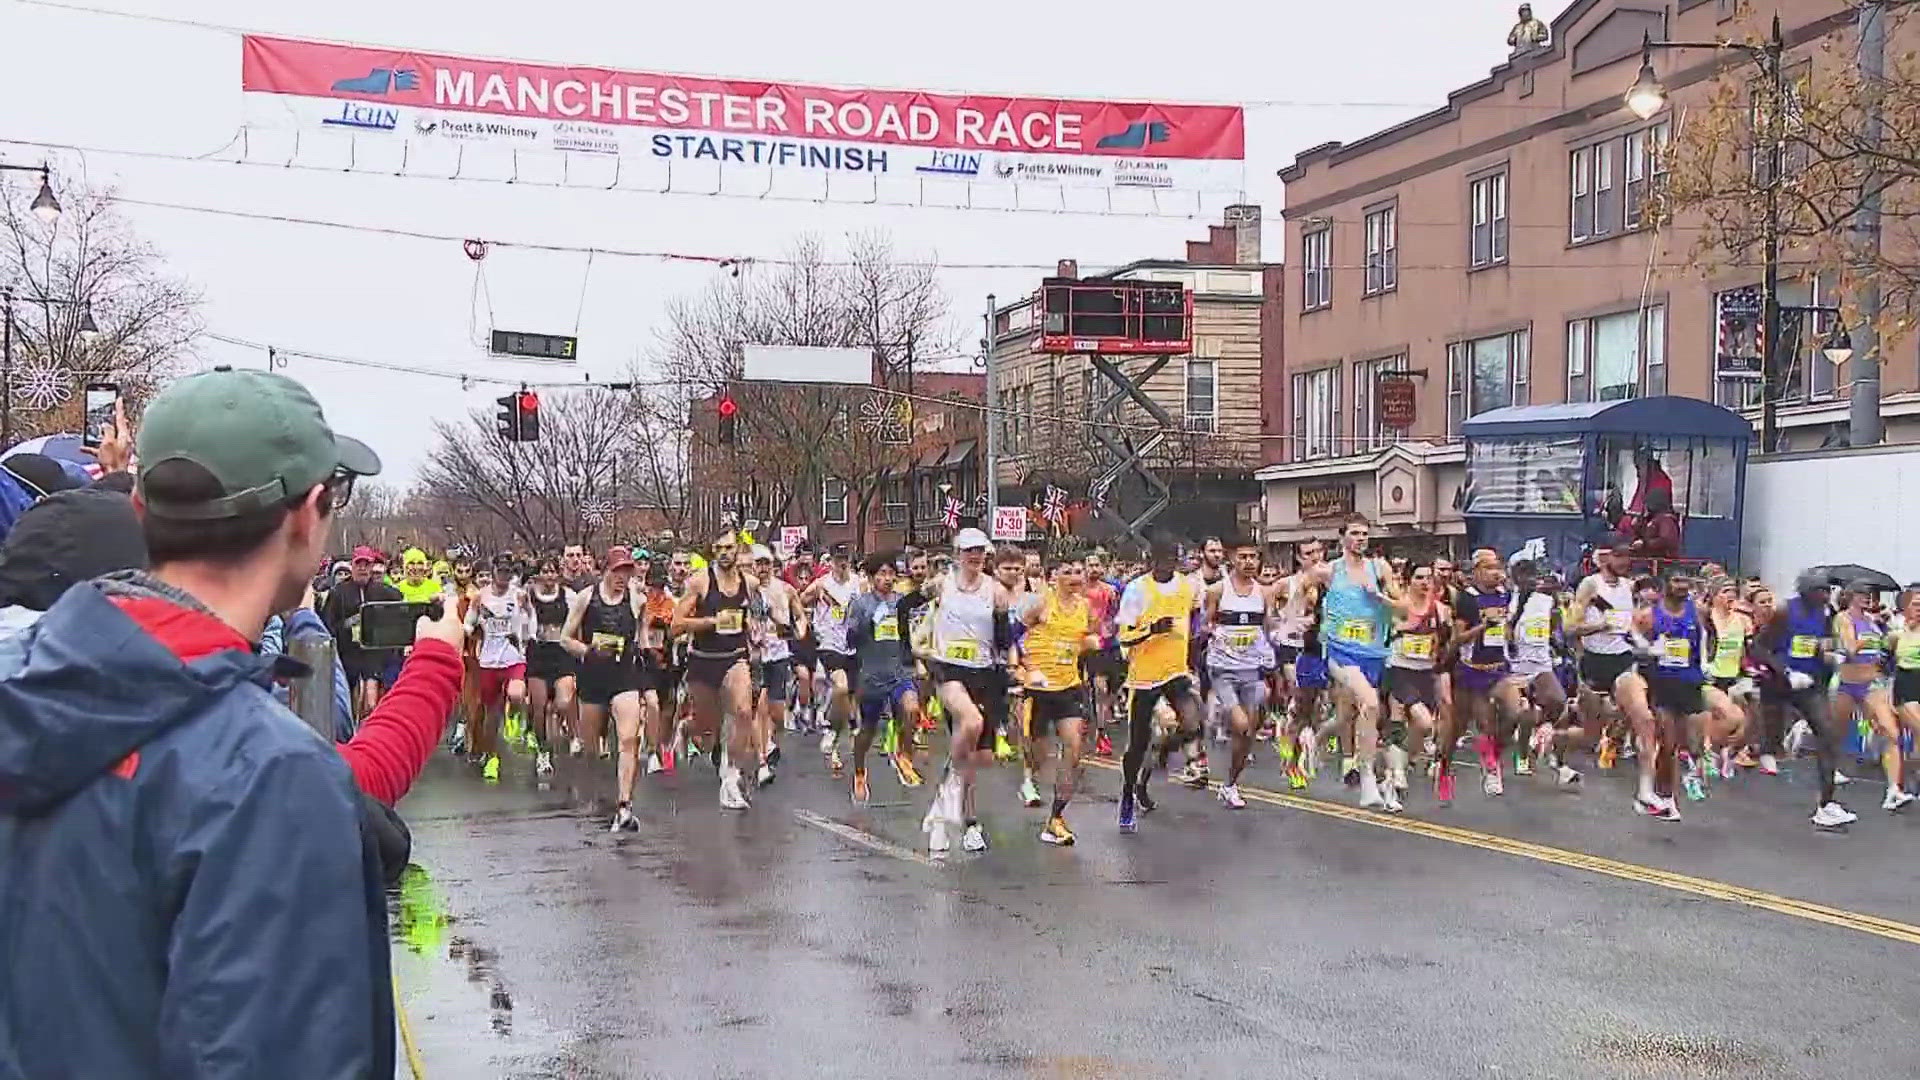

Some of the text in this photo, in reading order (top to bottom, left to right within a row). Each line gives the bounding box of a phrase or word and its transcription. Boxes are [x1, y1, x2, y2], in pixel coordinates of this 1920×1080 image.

[435, 68, 1083, 151] MANCHESTER ROAD RACE
[441, 119, 474, 133] Pratt
[476, 123, 484, 133] &
[486, 123, 538, 139] Whitney
[652, 134, 888, 172] START/FINISH
[1017, 162, 1046, 174] Pratt
[1048, 164, 1055, 174] &
[1056, 164, 1102, 178] Whitney
[996, 517, 1022, 530] U-30
